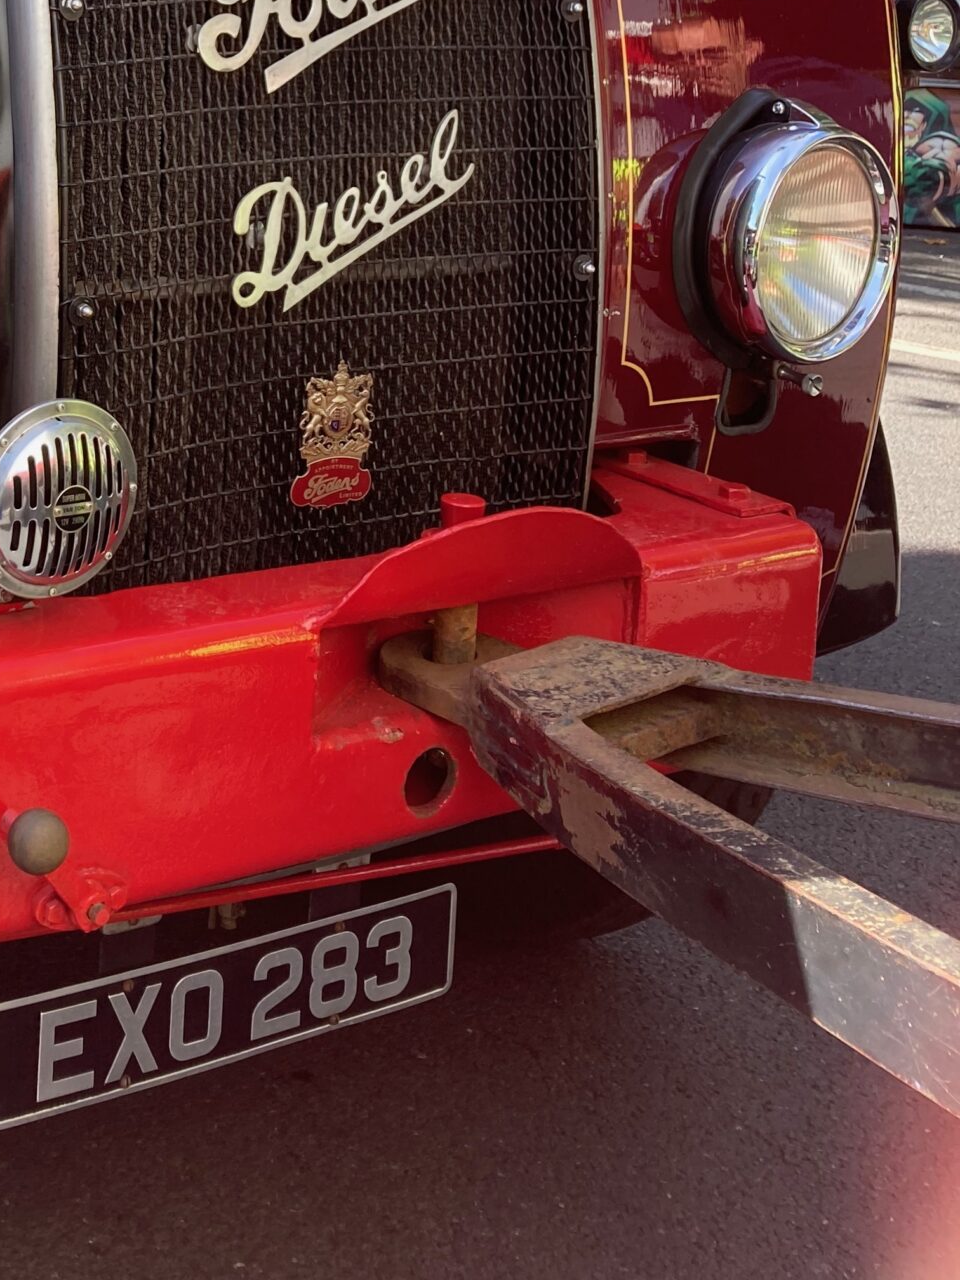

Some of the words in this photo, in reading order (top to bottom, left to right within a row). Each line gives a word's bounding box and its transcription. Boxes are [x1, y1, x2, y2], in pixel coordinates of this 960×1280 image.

[233, 109, 475, 312] Diesel
[303, 472, 360, 503] Fodens
[37, 969, 224, 1102] EXO
[251, 916, 413, 1040] 283
